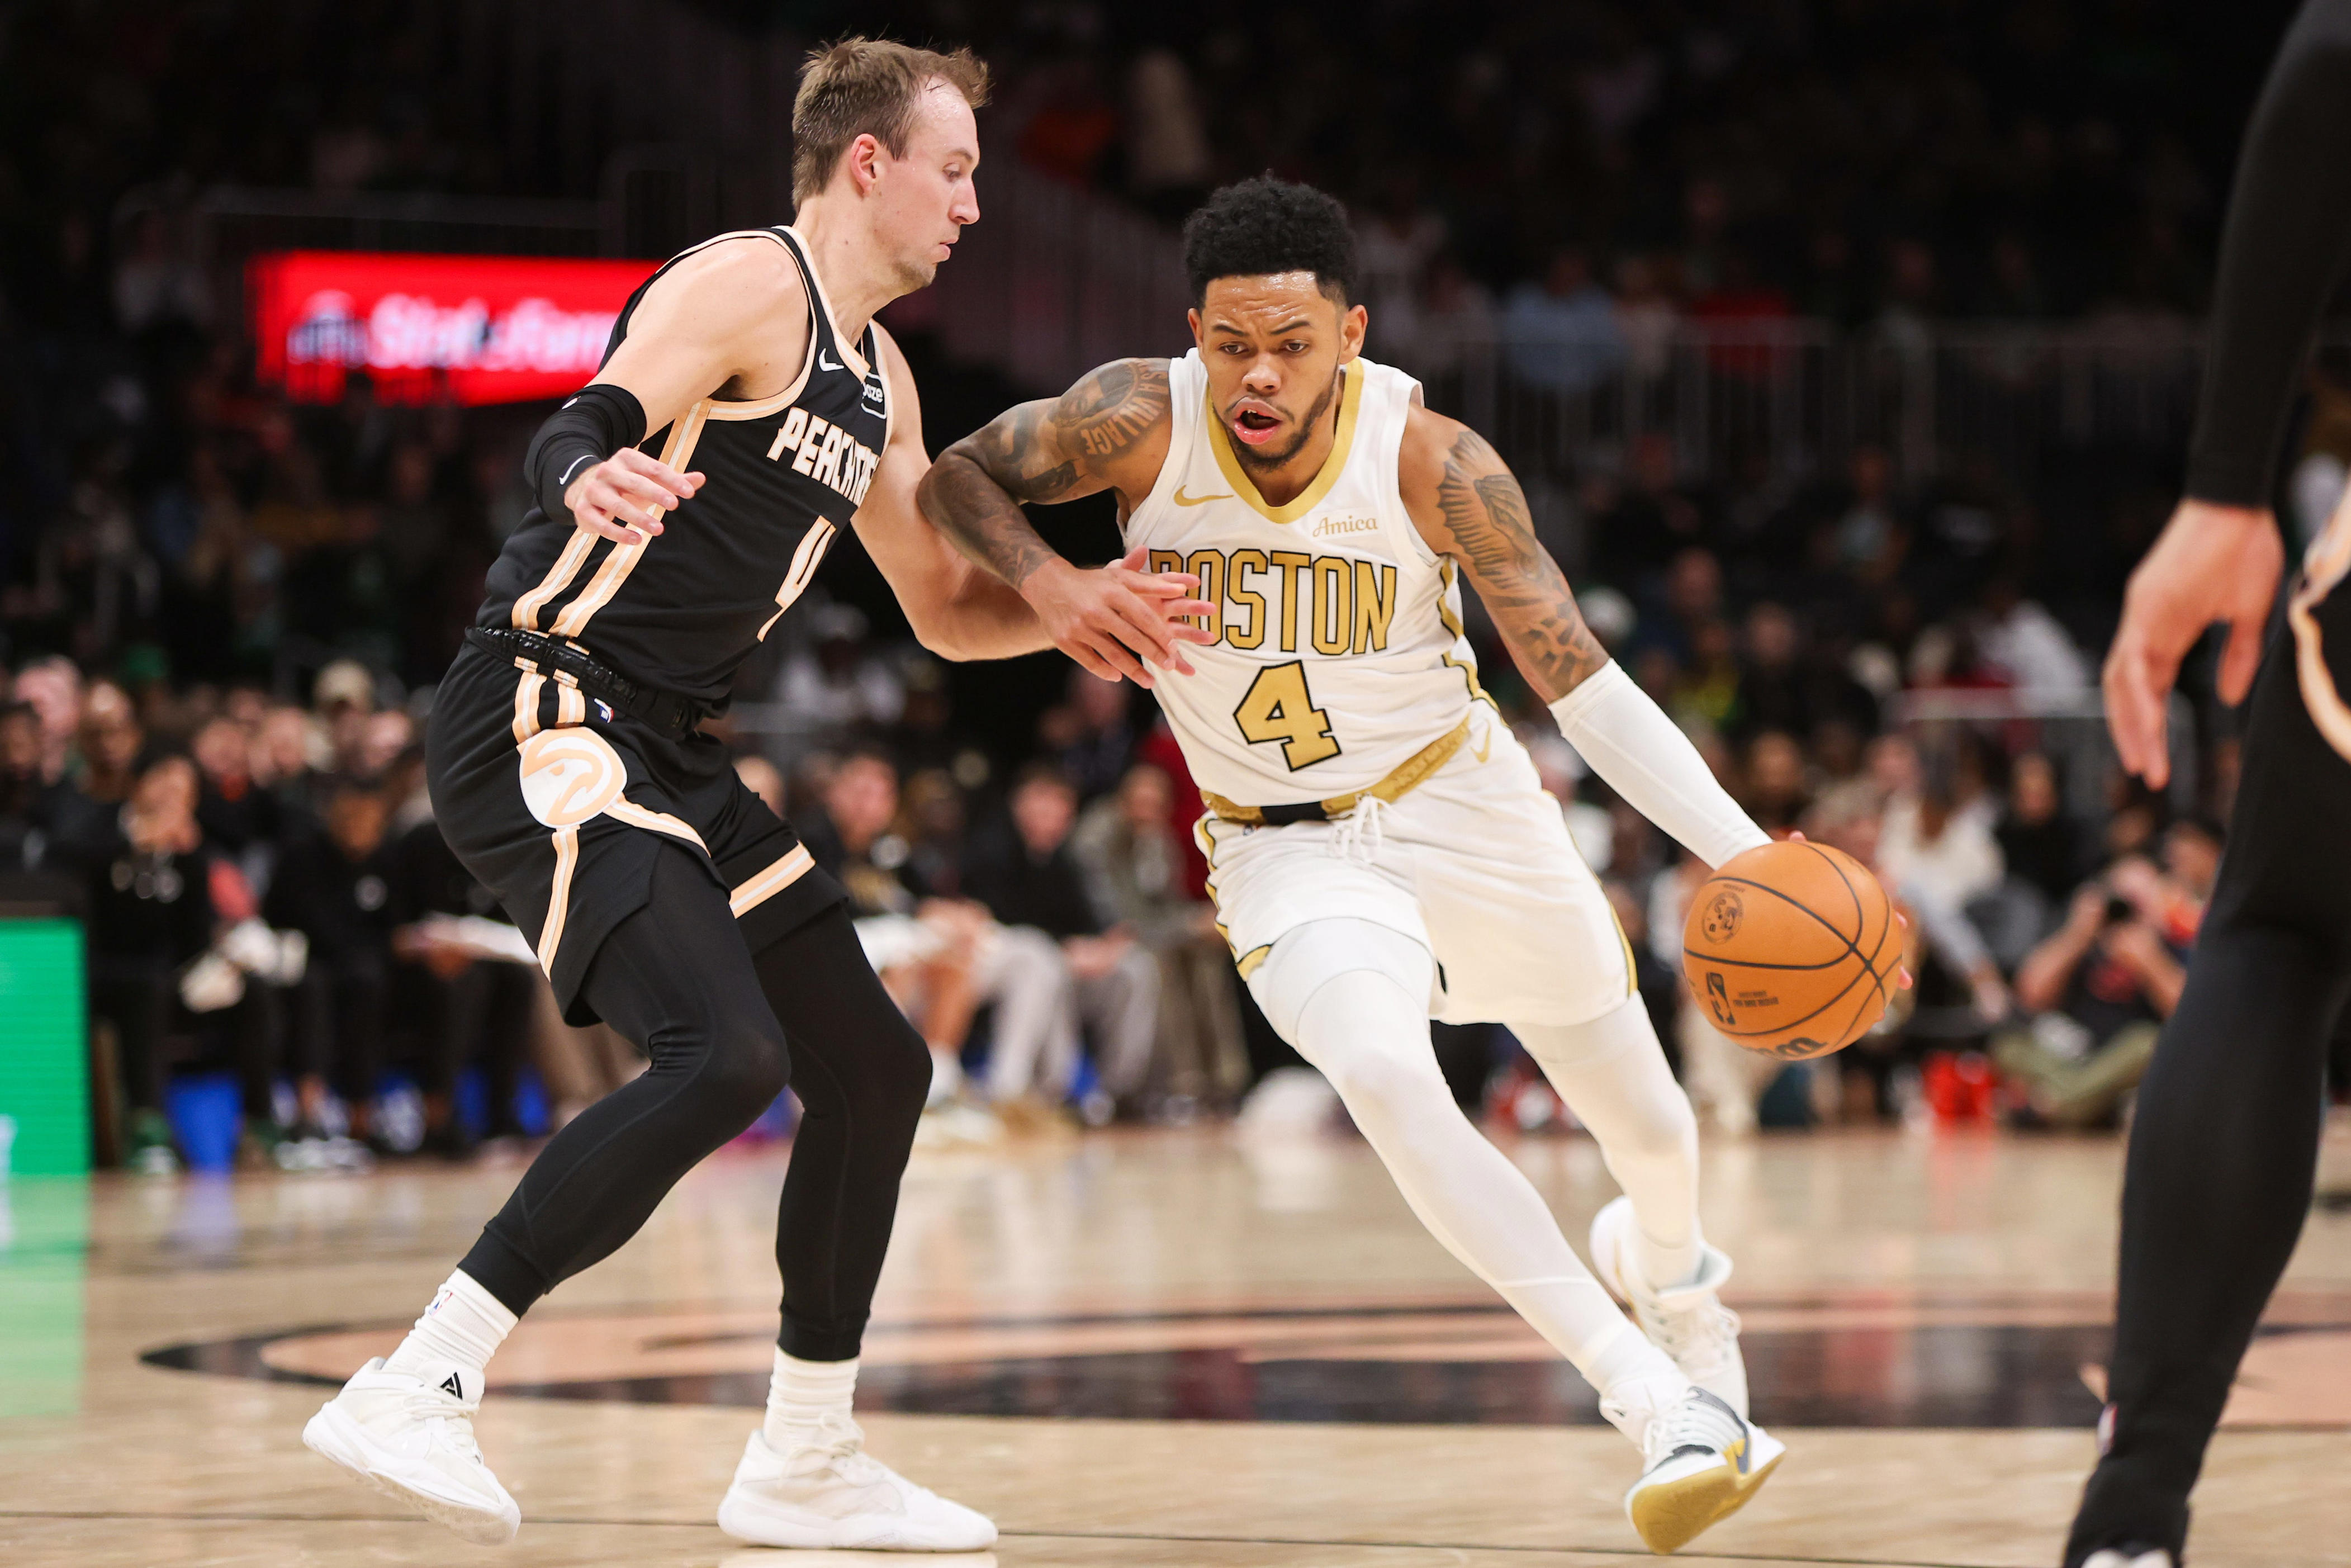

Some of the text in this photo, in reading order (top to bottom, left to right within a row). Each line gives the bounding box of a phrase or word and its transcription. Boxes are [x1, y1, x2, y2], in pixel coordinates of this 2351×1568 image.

[1312, 515, 1378, 537] Amica
[1149, 548, 1396, 655] OSTON
[1233, 660, 1342, 773] 4
